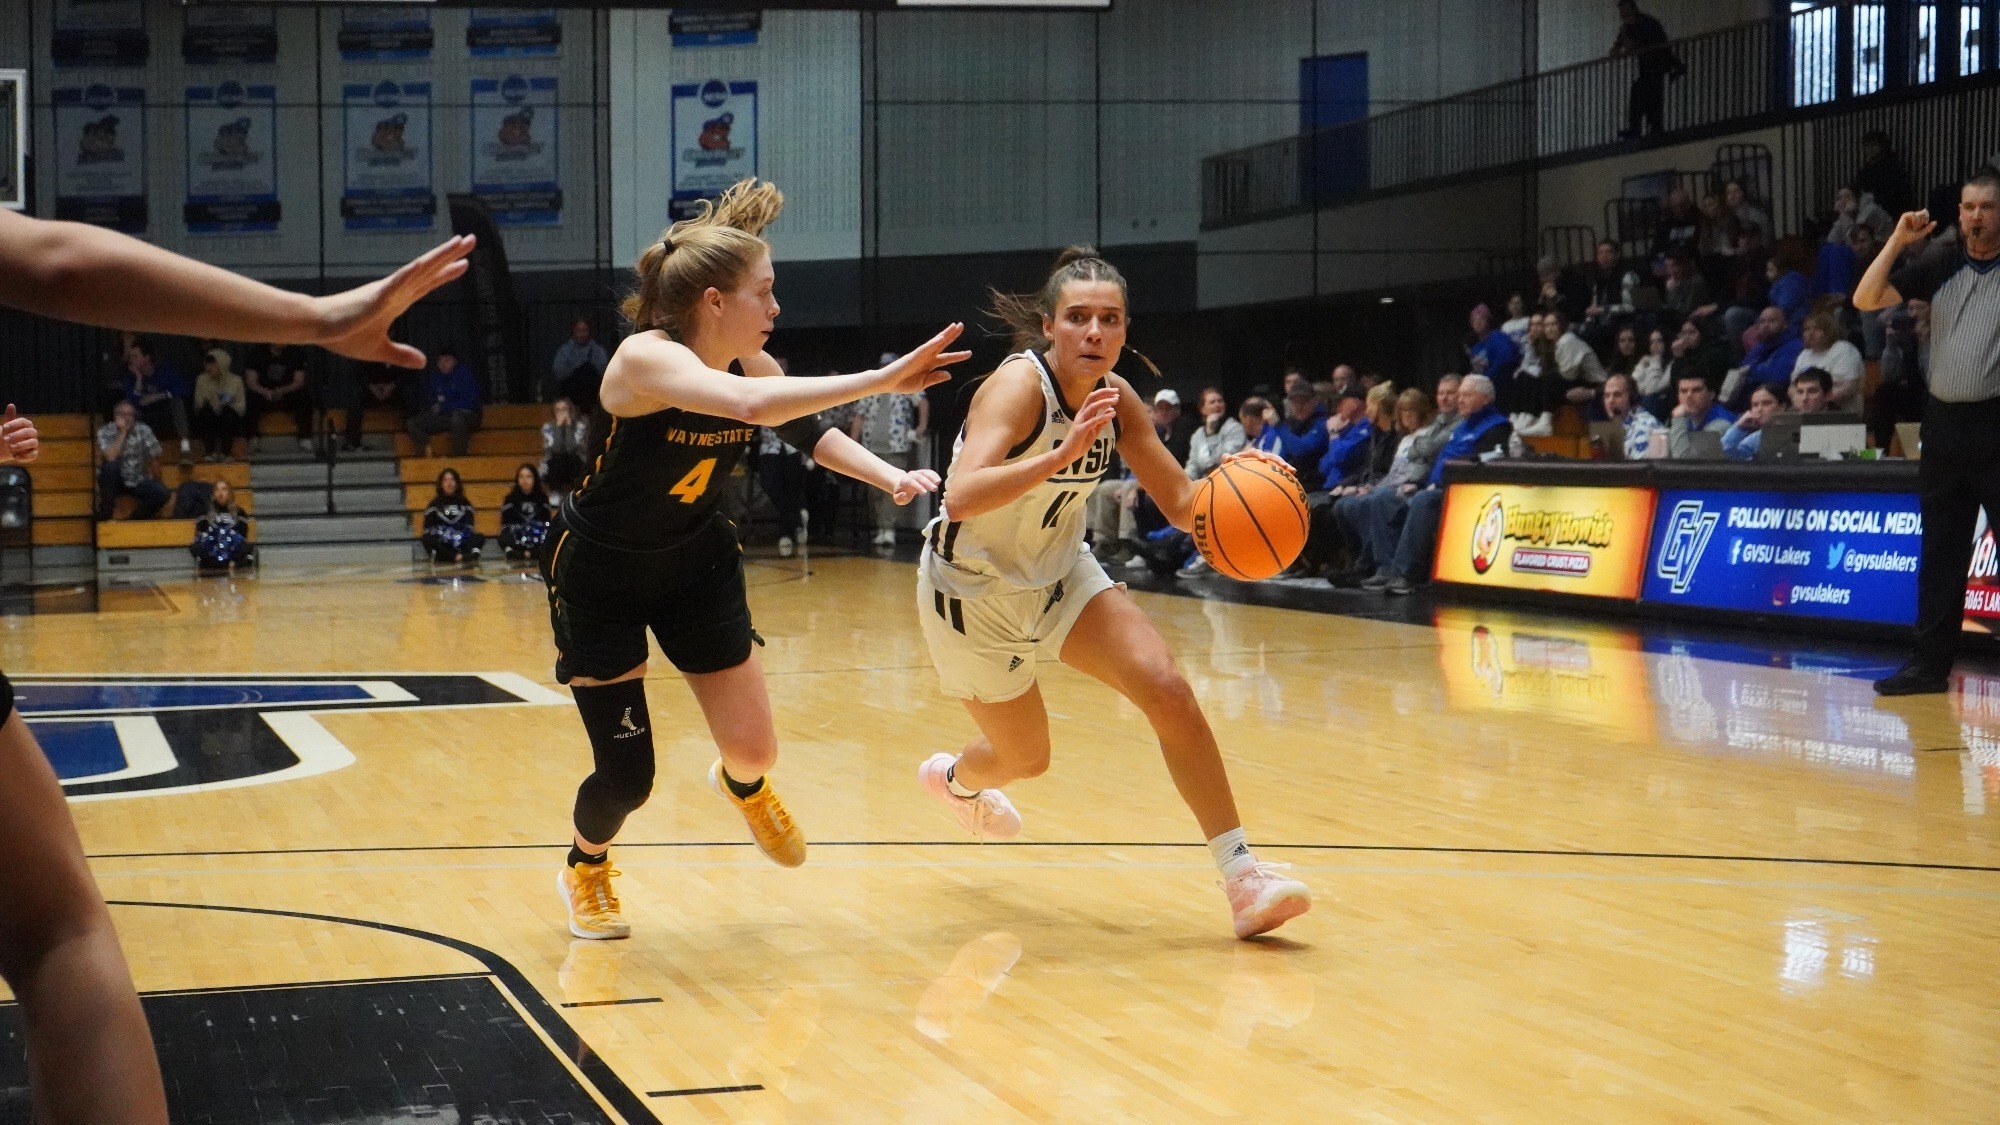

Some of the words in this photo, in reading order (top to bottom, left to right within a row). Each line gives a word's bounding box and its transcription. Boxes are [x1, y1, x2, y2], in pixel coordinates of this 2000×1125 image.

[669, 457, 717, 504] 4
[1041, 490, 1079, 529] 11
[1727, 506, 1785, 529] FOLLOW
[1785, 509, 1805, 531] US
[1805, 509, 1829, 531] ON
[1828, 510, 1881, 533] SOCIAL
[1883, 512, 1923, 535] MEDI
[1504, 505, 1558, 546] Hungry
[1742, 543, 1775, 563] GVSU
[1774, 546, 1812, 566] Lakers
[1843, 548, 1918, 573] @gvsulakers
[1790, 582, 1851, 605] gvsulakers
[613, 727, 646, 739] MUELLER
